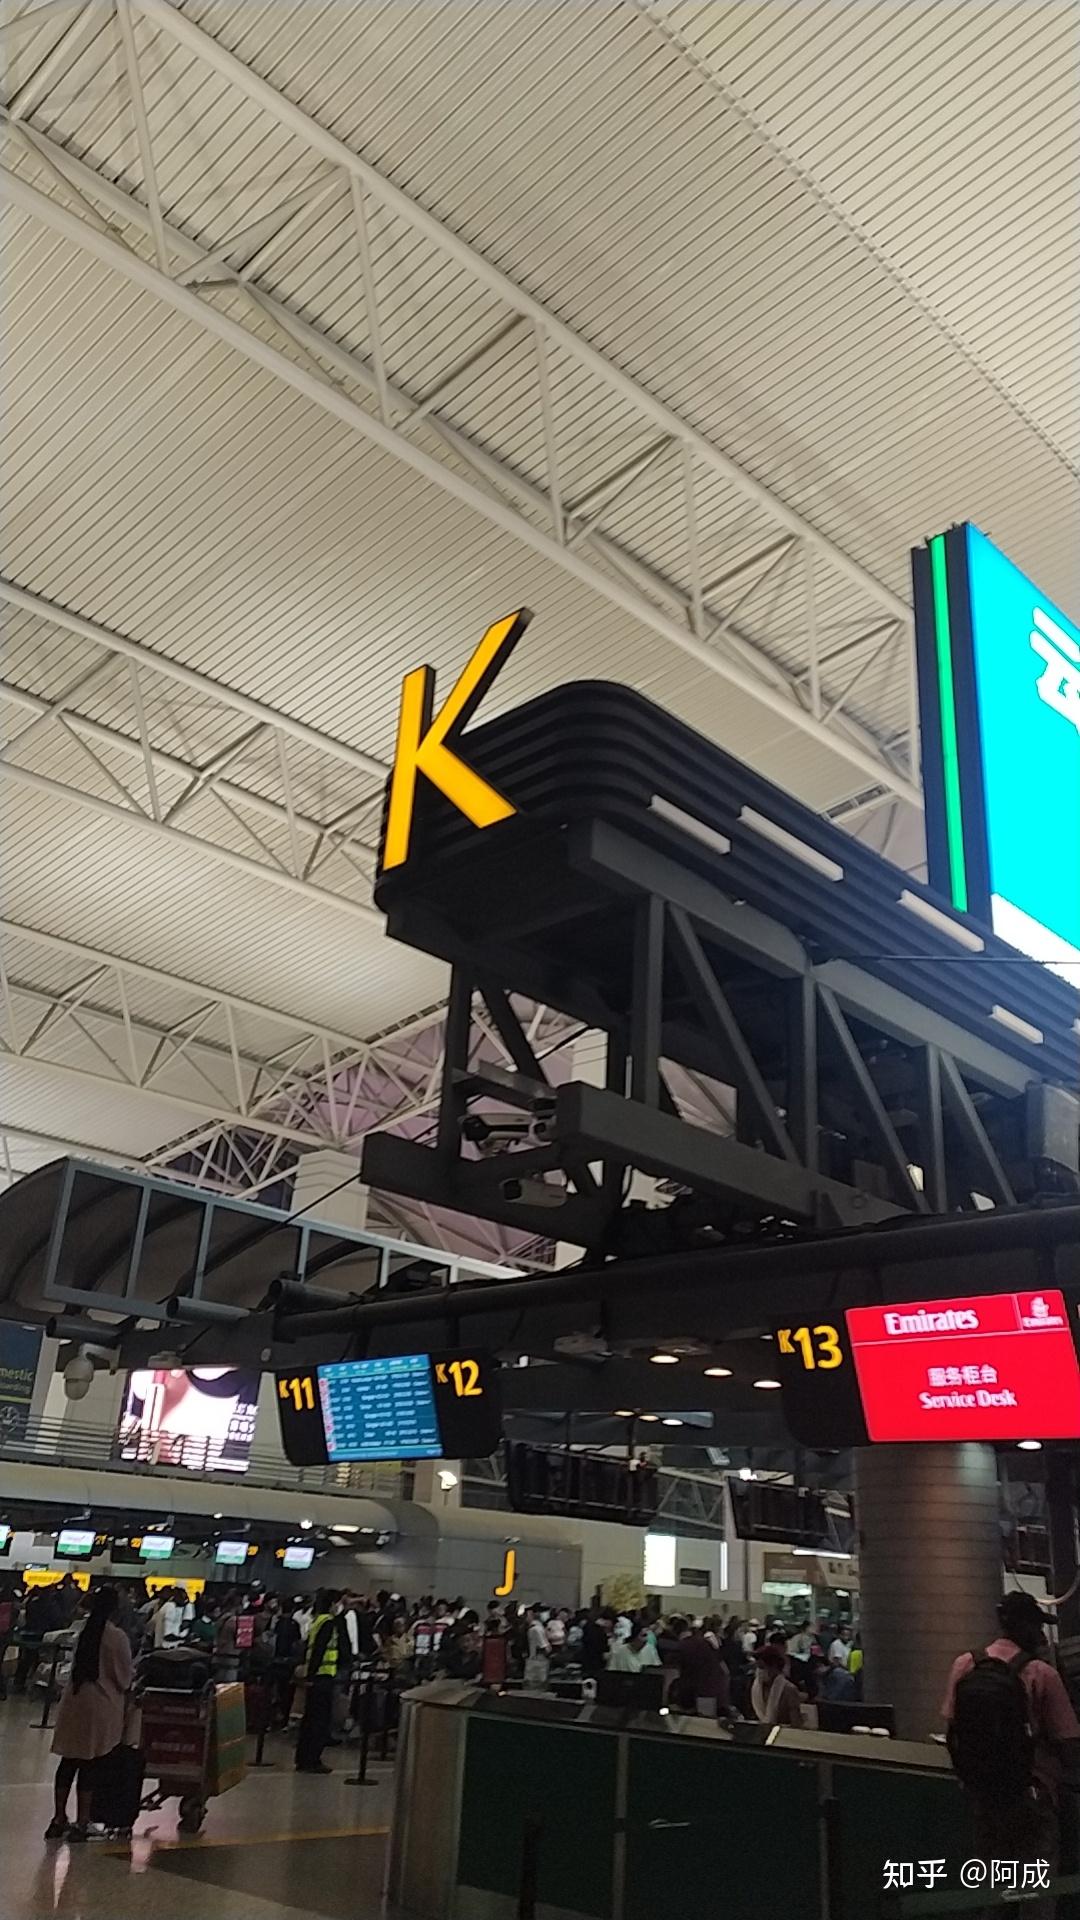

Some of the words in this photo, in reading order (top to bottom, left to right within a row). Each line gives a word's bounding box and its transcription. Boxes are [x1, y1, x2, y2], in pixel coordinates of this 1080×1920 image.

[382, 608, 522, 871] K
[883, 1308, 979, 1335] Emirates
[777, 1325, 843, 1370] K13
[279, 1376, 315, 1411] K11
[435, 1359, 482, 1397] K12
[927, 1364, 998, 1387] 服务柜台
[919, 1391, 976, 1409] Service
[976, 1389, 1018, 1407] Desk
[495, 1550, 515, 1596] J
